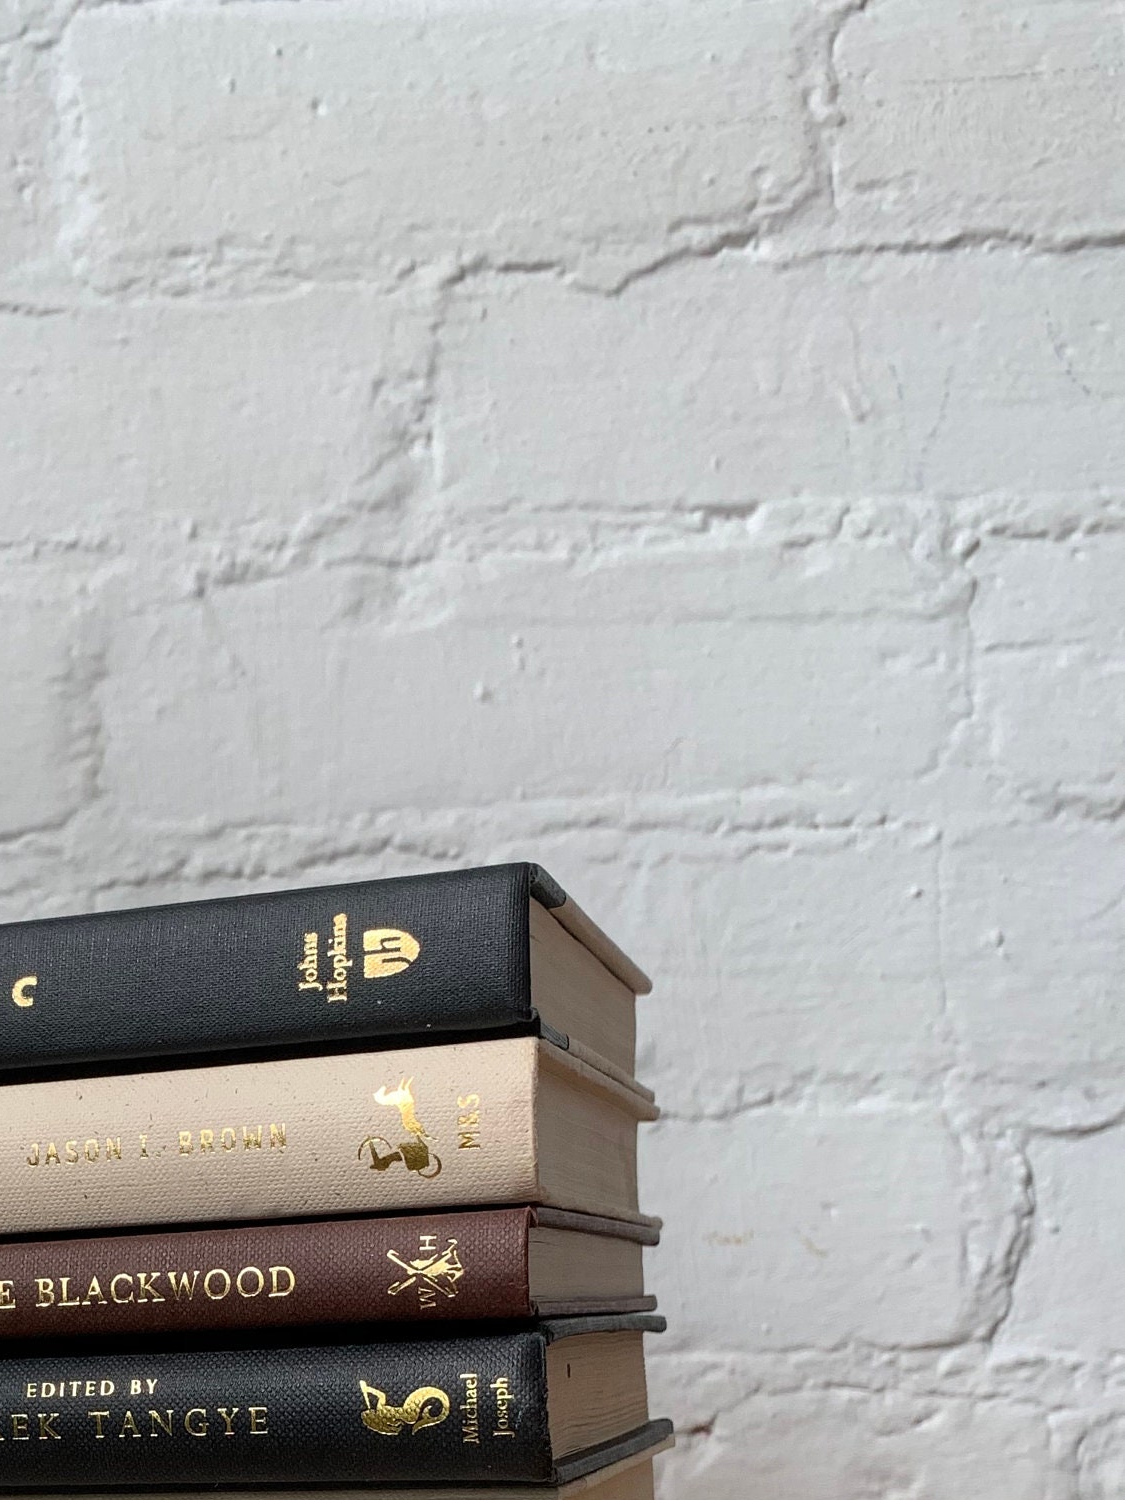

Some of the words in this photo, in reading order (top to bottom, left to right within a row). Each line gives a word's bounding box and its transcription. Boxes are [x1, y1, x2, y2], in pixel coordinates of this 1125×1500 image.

[297, 932, 324, 991] Johns
[326, 913, 353, 1003] Hopkins
[26, 1135, 122, 1168] JASON
[178, 1122, 287, 1156] BROWN
[35, 1264, 297, 1307] BLACKWOOD
[26, 1380, 114, 1399] EDITED
[129, 1378, 159, 1397] BY
[460, 1372, 480, 1445] Michael
[489, 1376, 516, 1439] Joseph
[88, 1406, 270, 1440] TANGYE
